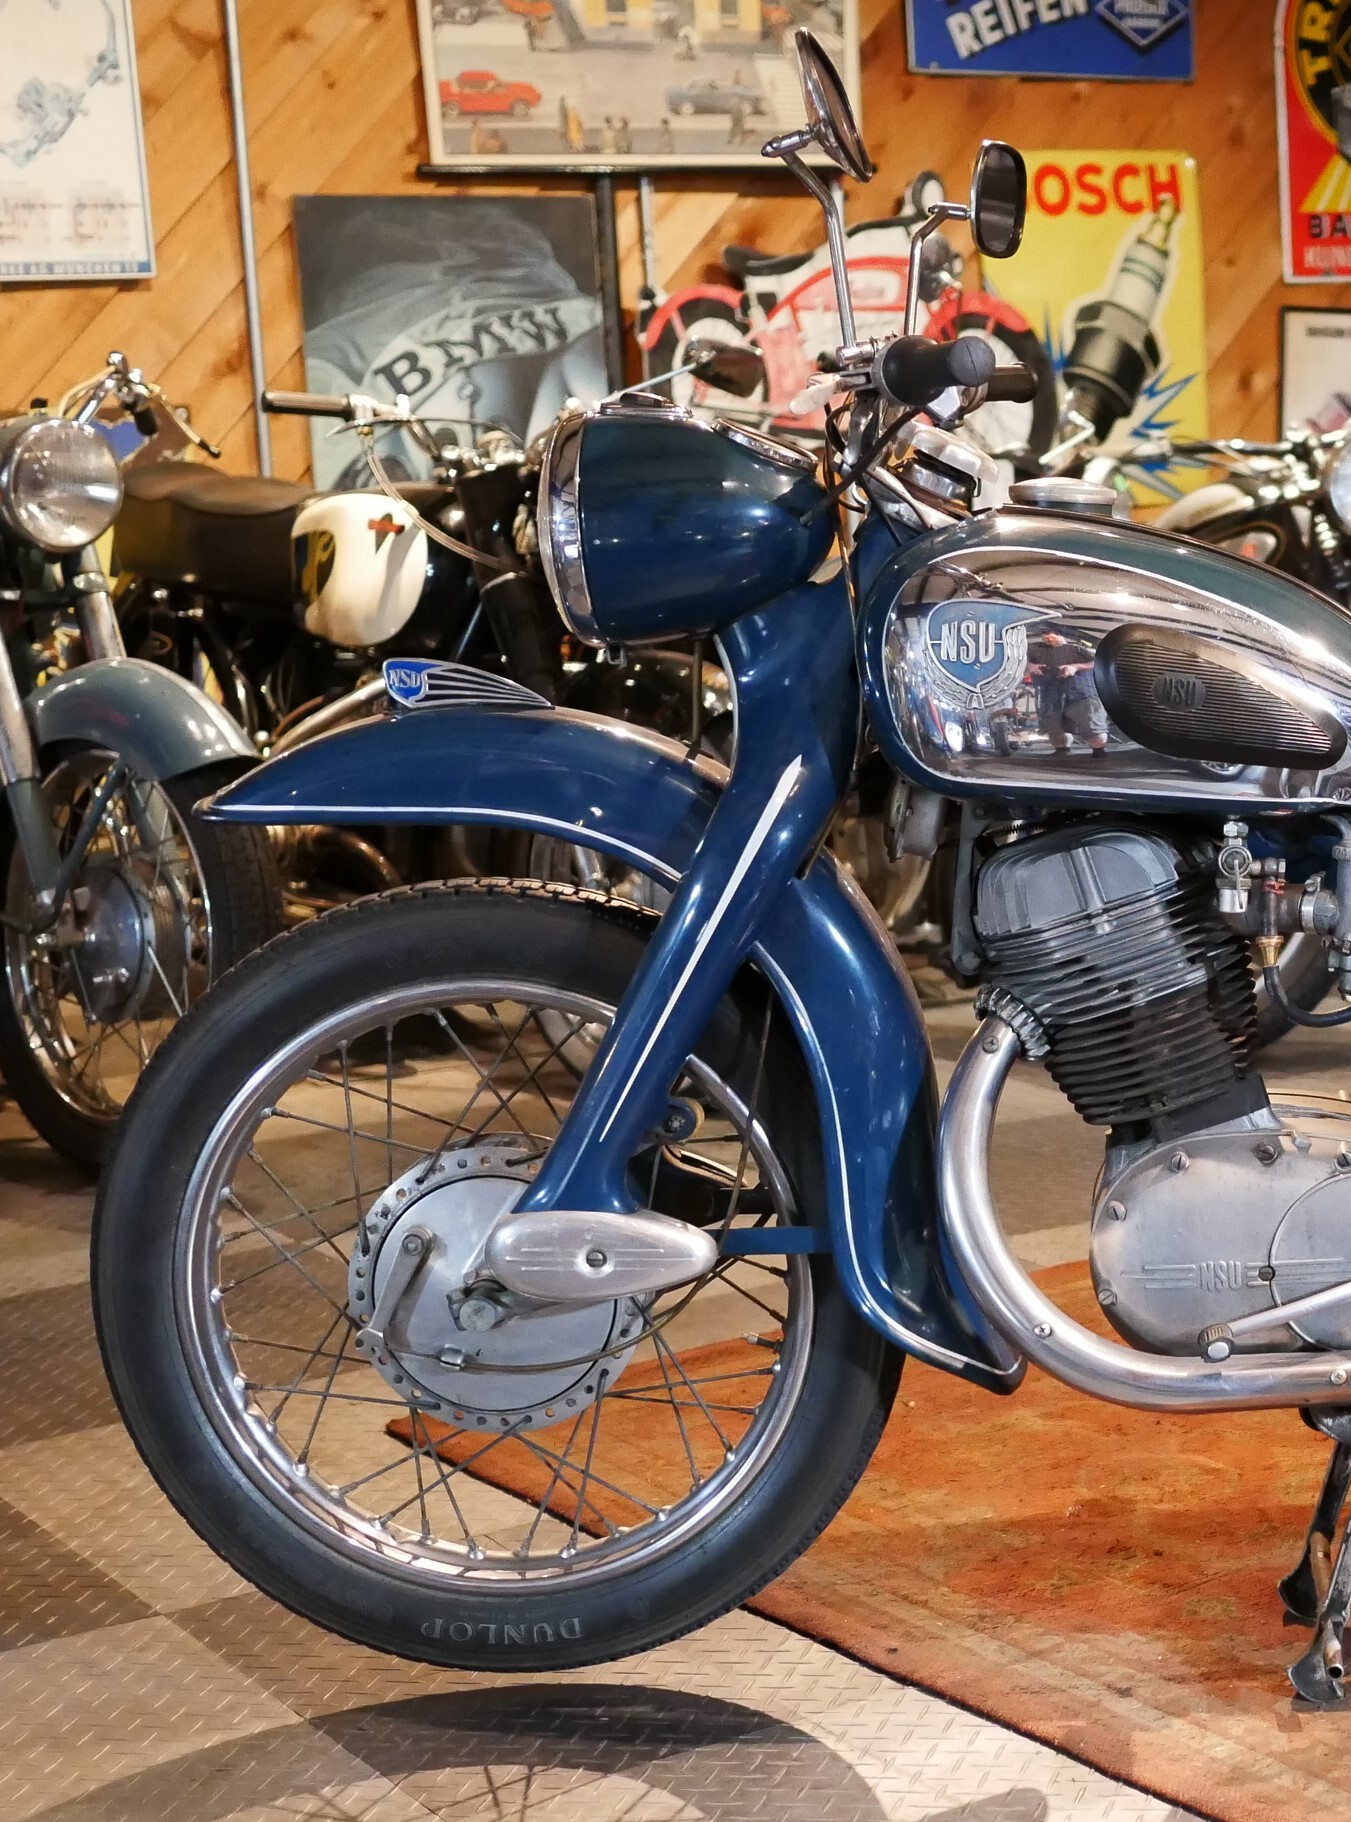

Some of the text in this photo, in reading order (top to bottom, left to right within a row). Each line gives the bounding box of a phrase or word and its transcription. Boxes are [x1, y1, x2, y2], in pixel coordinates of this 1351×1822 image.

[1026, 163, 1182, 216] OSCH
[373, 306, 568, 398] BMW
[938, 618, 997, 666] NSU
[388, 668, 422, 689] NSU
[1159, 676, 1197, 705] NSU
[1200, 1260, 1242, 1292] NSU
[419, 1617, 583, 1645] DUNLOP
